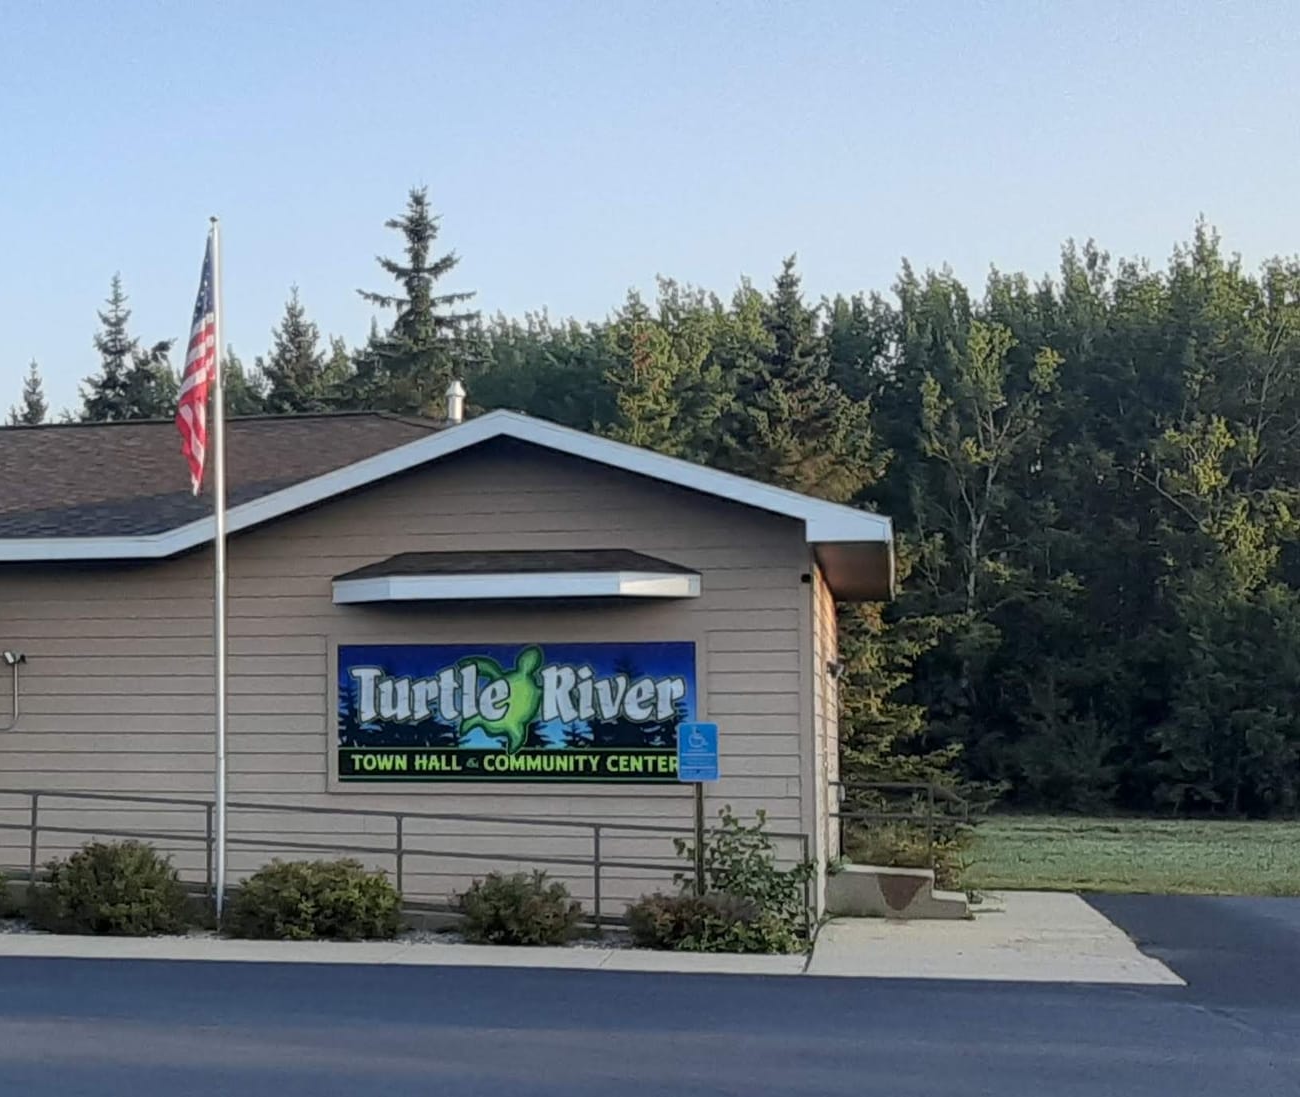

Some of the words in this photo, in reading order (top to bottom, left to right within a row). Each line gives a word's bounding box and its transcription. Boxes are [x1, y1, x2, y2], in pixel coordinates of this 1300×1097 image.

[351, 664, 510, 722] Turtle
[540, 664, 685, 722] River
[352, 754, 407, 771] TOWN
[414, 754, 462, 771] HALL
[483, 754, 599, 772] COMMUNITY
[606, 755, 678, 772] CENTER
